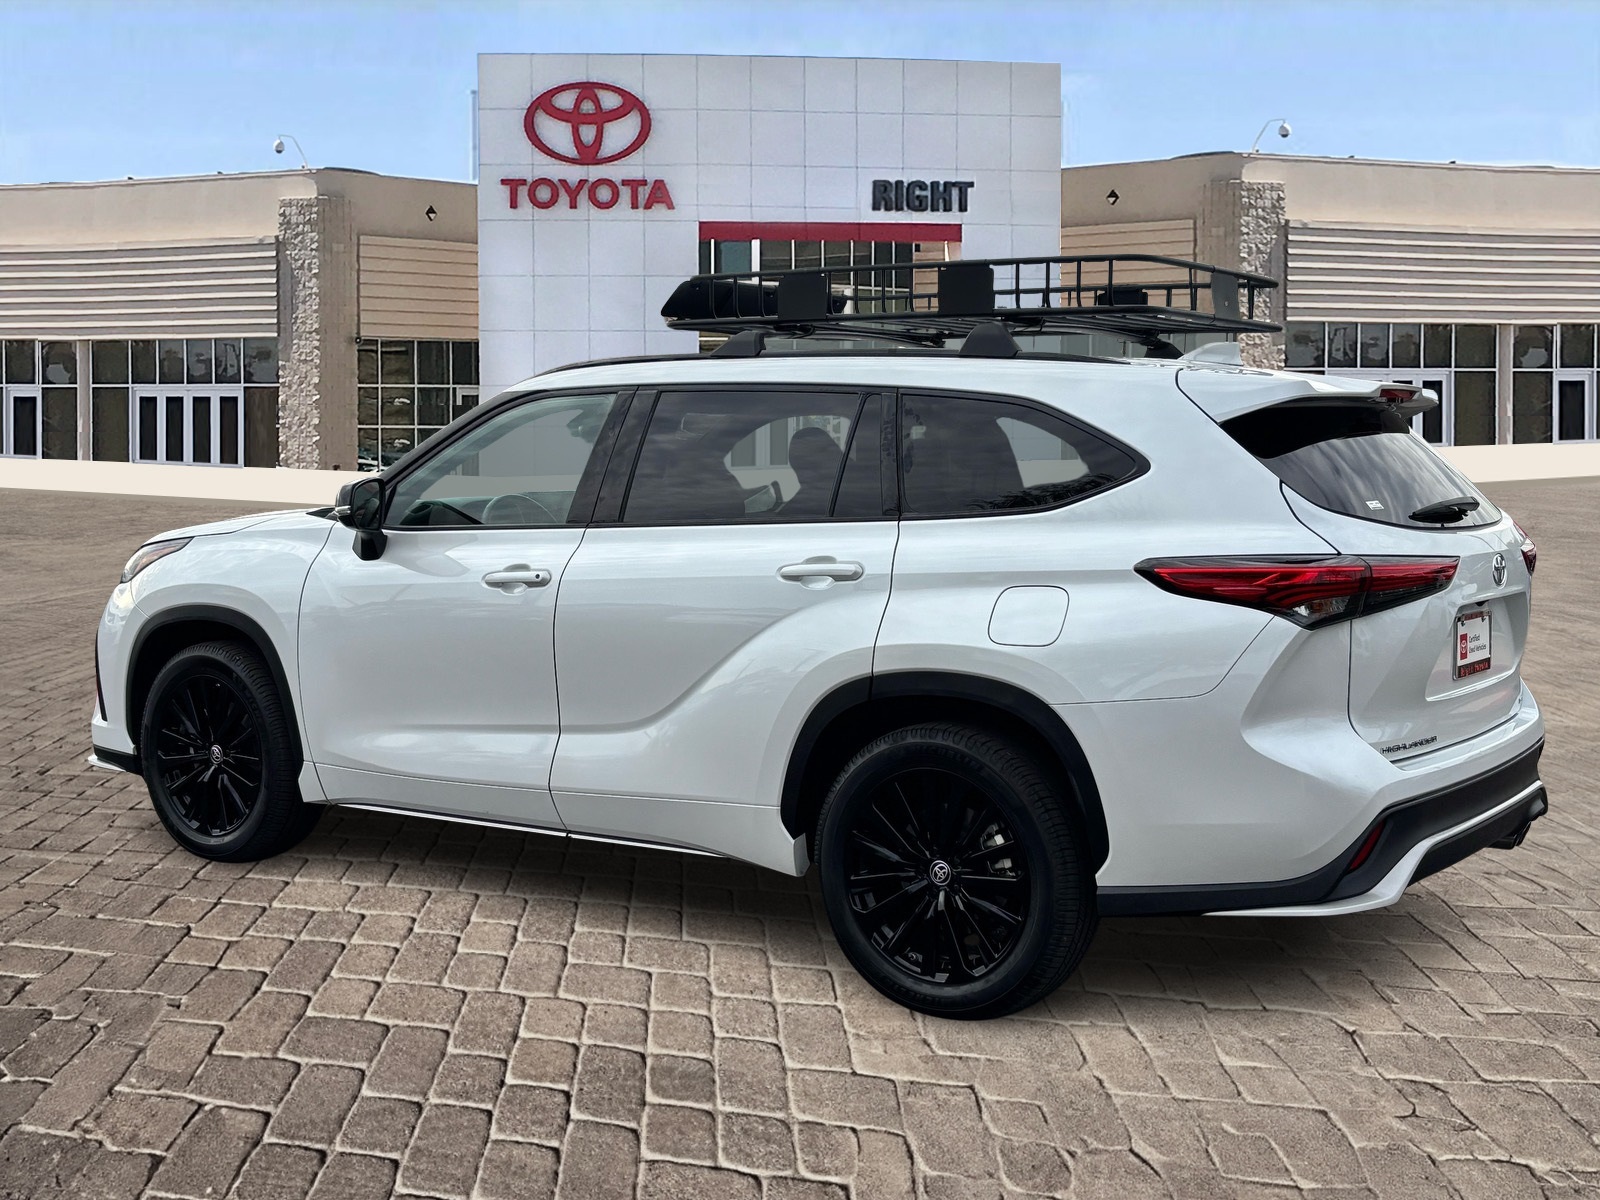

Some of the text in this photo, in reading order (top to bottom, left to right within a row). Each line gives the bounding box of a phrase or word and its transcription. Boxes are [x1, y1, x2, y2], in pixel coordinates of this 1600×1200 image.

[500, 178, 675, 210] TOYOTA
[872, 179, 975, 212] RIGHT
[1380, 735, 1438, 754] HIGHLANDER
